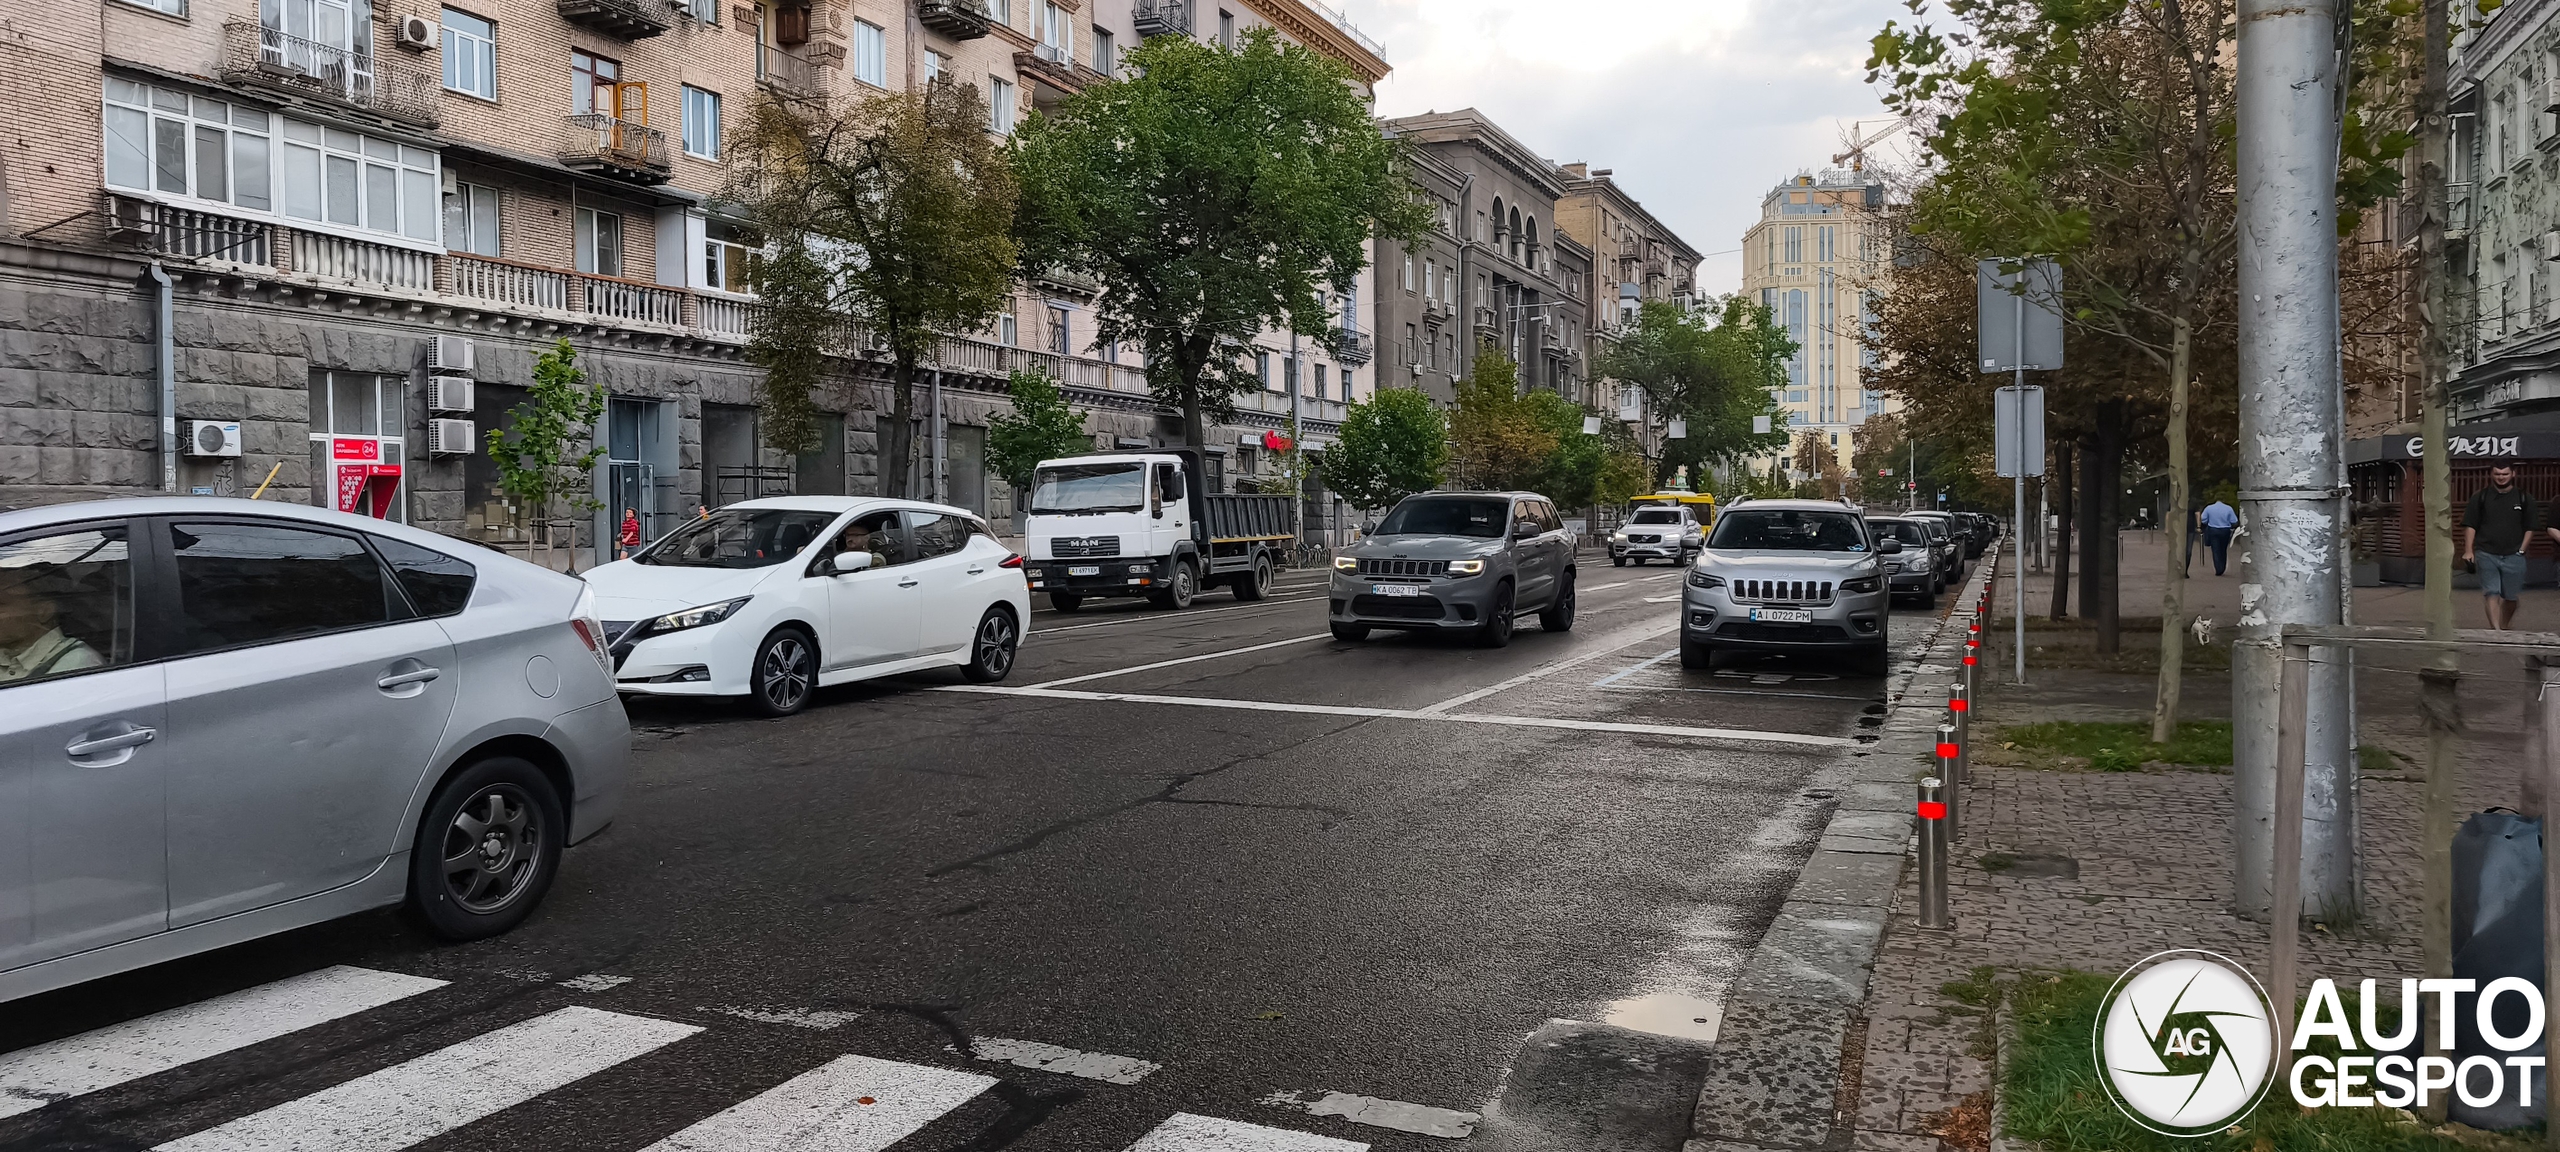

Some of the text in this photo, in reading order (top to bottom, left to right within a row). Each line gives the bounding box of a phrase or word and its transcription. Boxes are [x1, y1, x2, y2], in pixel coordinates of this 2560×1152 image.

[364, 445, 374, 454] 24
[2406, 436, 2519, 457] ЄРАЗІЯ
[1070, 539, 1099, 547] MAN
[1388, 586, 1405, 594] 0062
[1407, 587, 1417, 595] TB
[1757, 610, 1810, 621] AI 0722 PM
